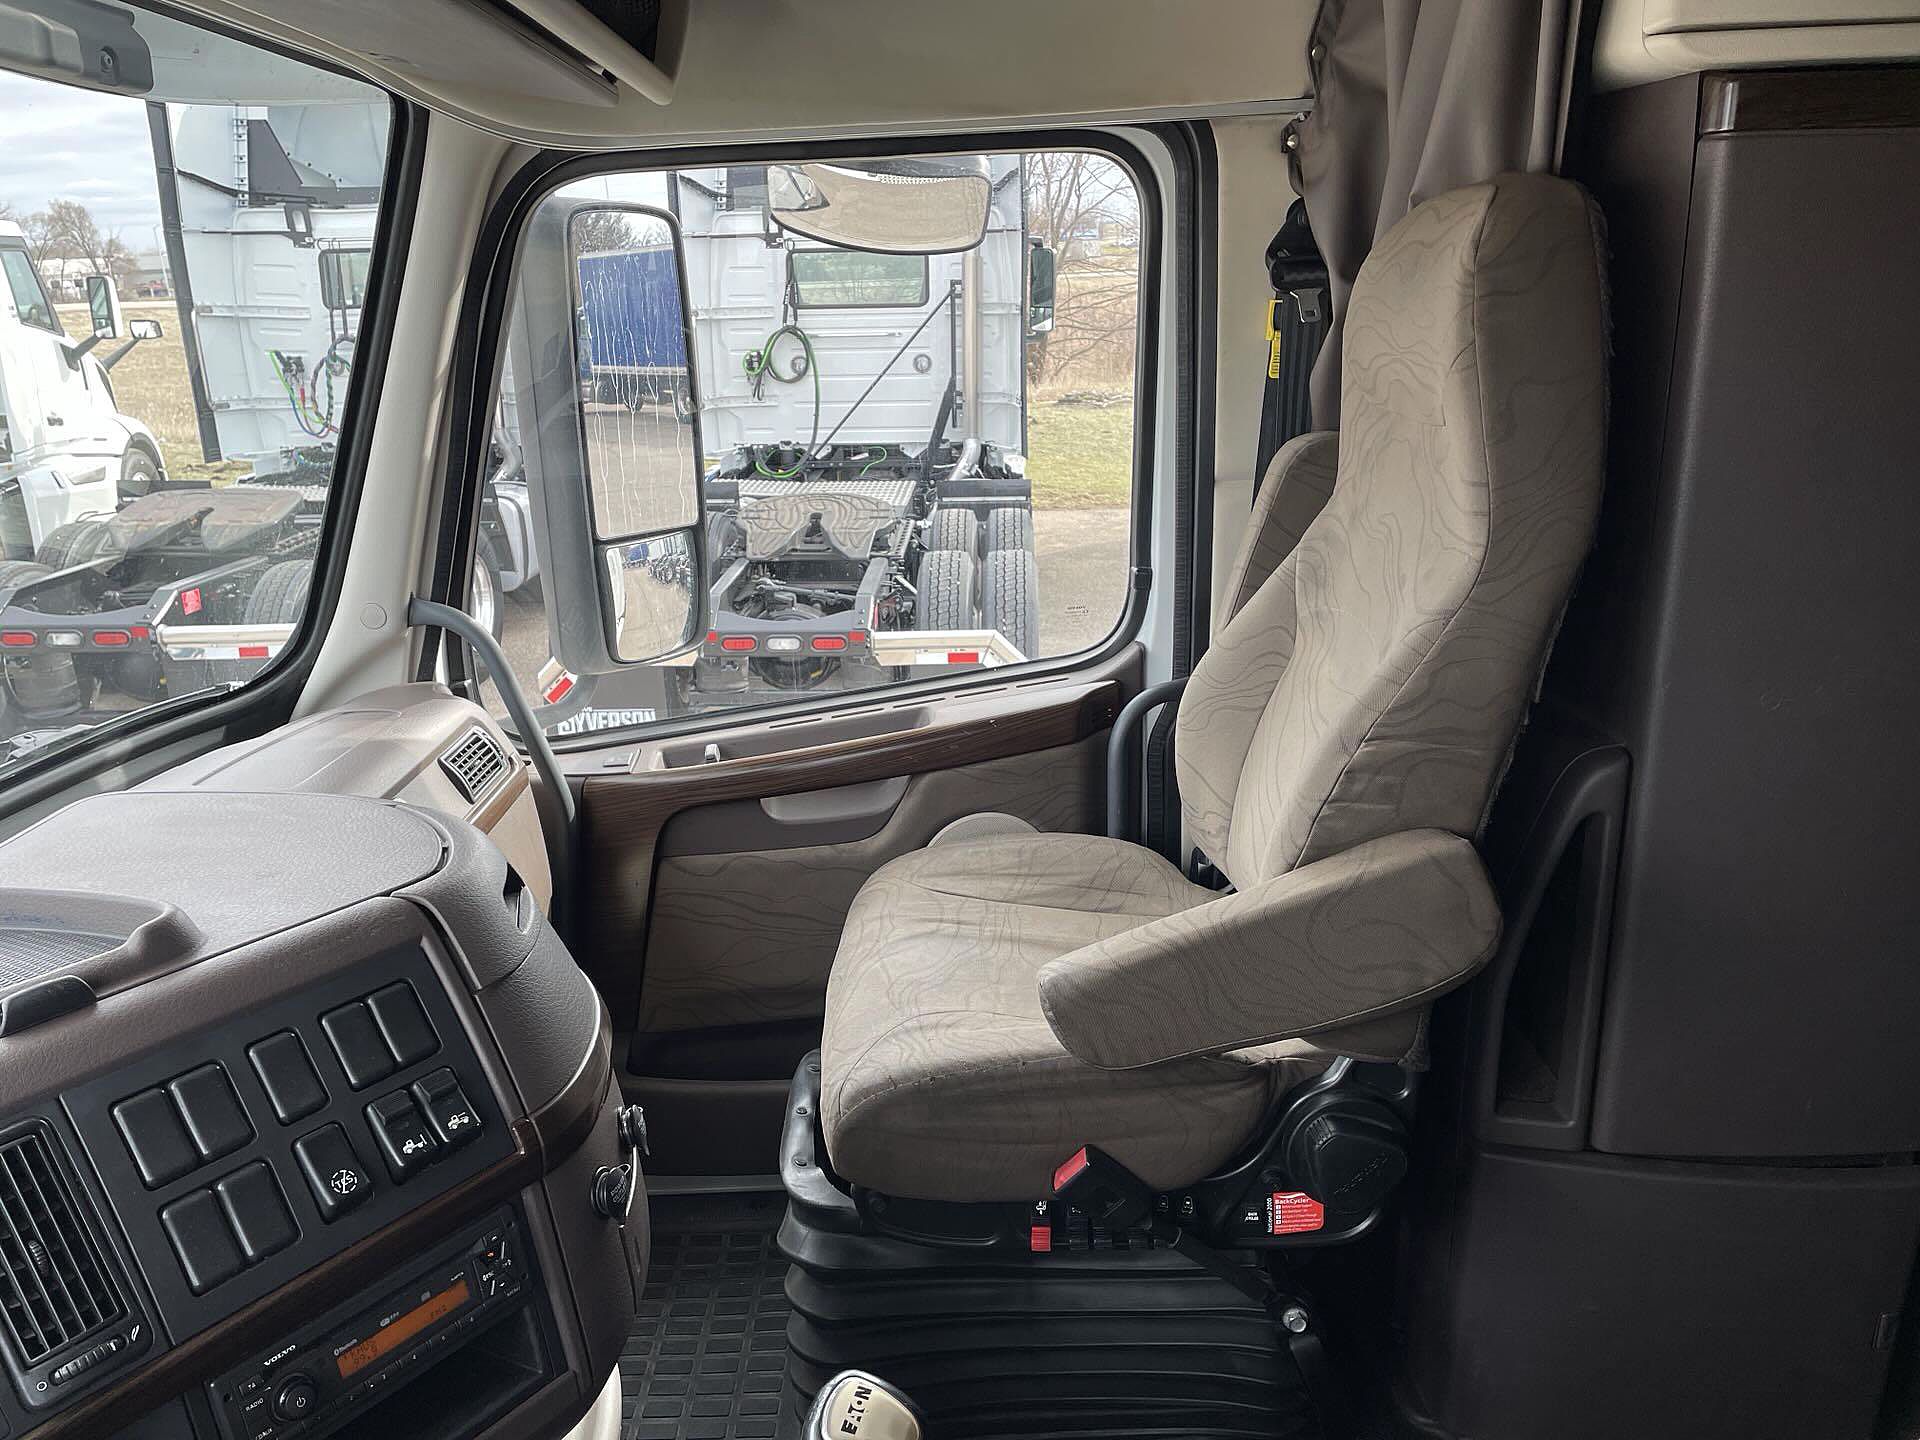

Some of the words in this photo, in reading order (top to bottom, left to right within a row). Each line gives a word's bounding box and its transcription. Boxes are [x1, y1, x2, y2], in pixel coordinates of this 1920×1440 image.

[263, 1344, 297, 1366] VOLVO
[245, 1397, 265, 1412] RADIO
[840, 1386, 873, 1435] EATON
